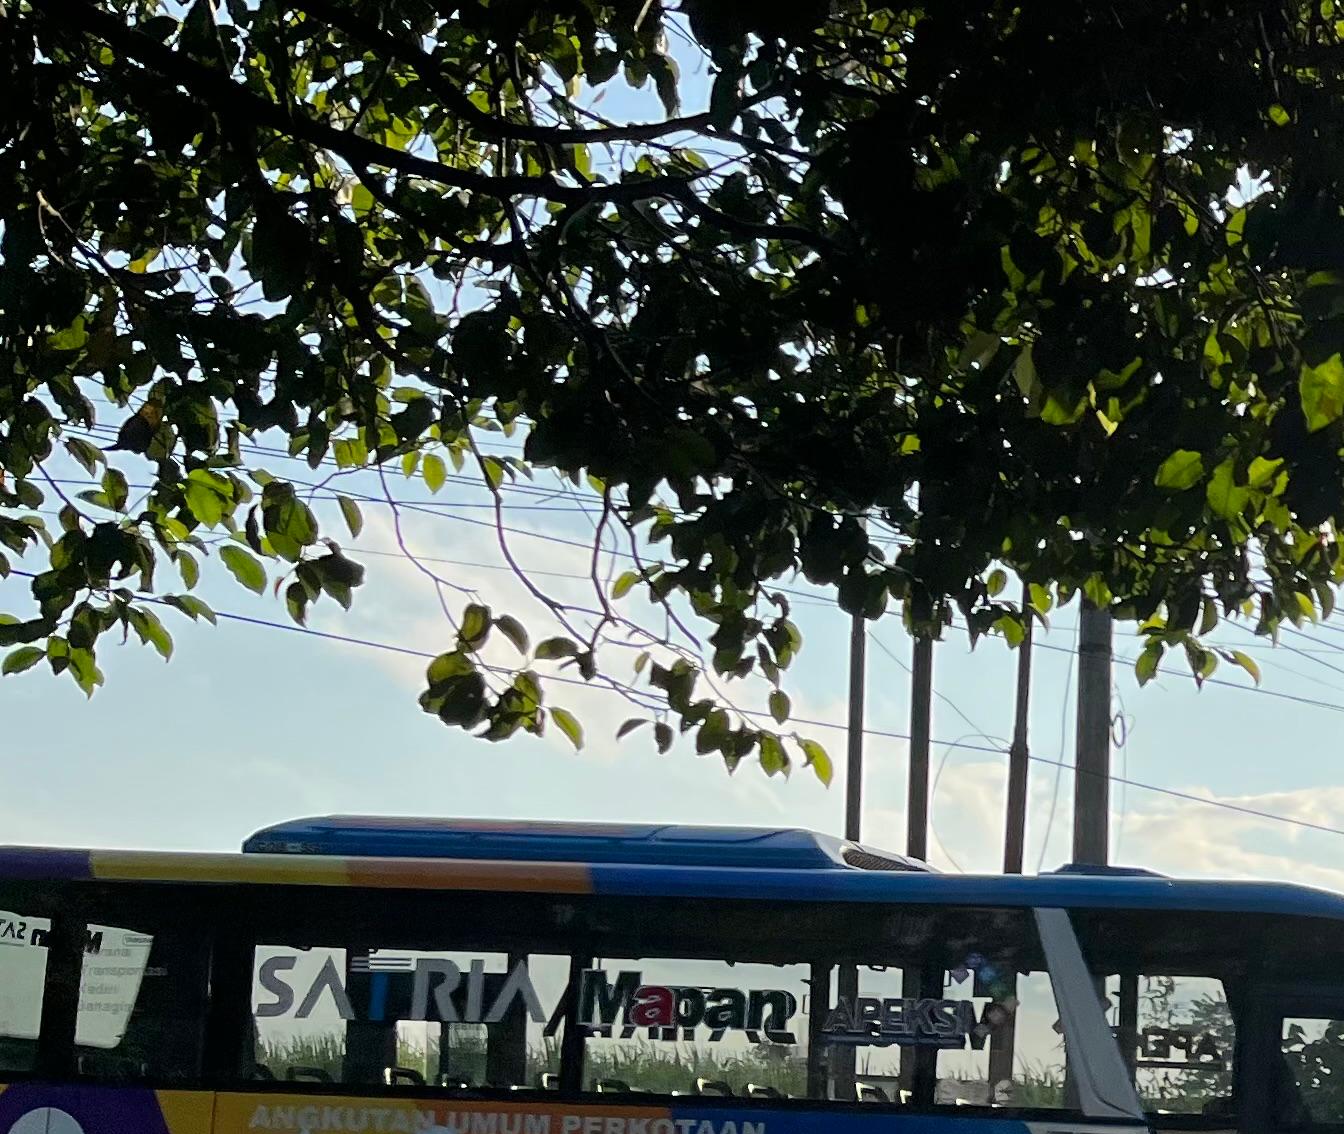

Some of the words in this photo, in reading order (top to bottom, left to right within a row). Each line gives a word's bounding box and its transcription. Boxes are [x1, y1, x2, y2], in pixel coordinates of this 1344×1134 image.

[256, 955, 548, 1023] SATRIA
[579, 968, 790, 1036] Mapan
[248, 1104, 435, 1133] ANGKUTAN
